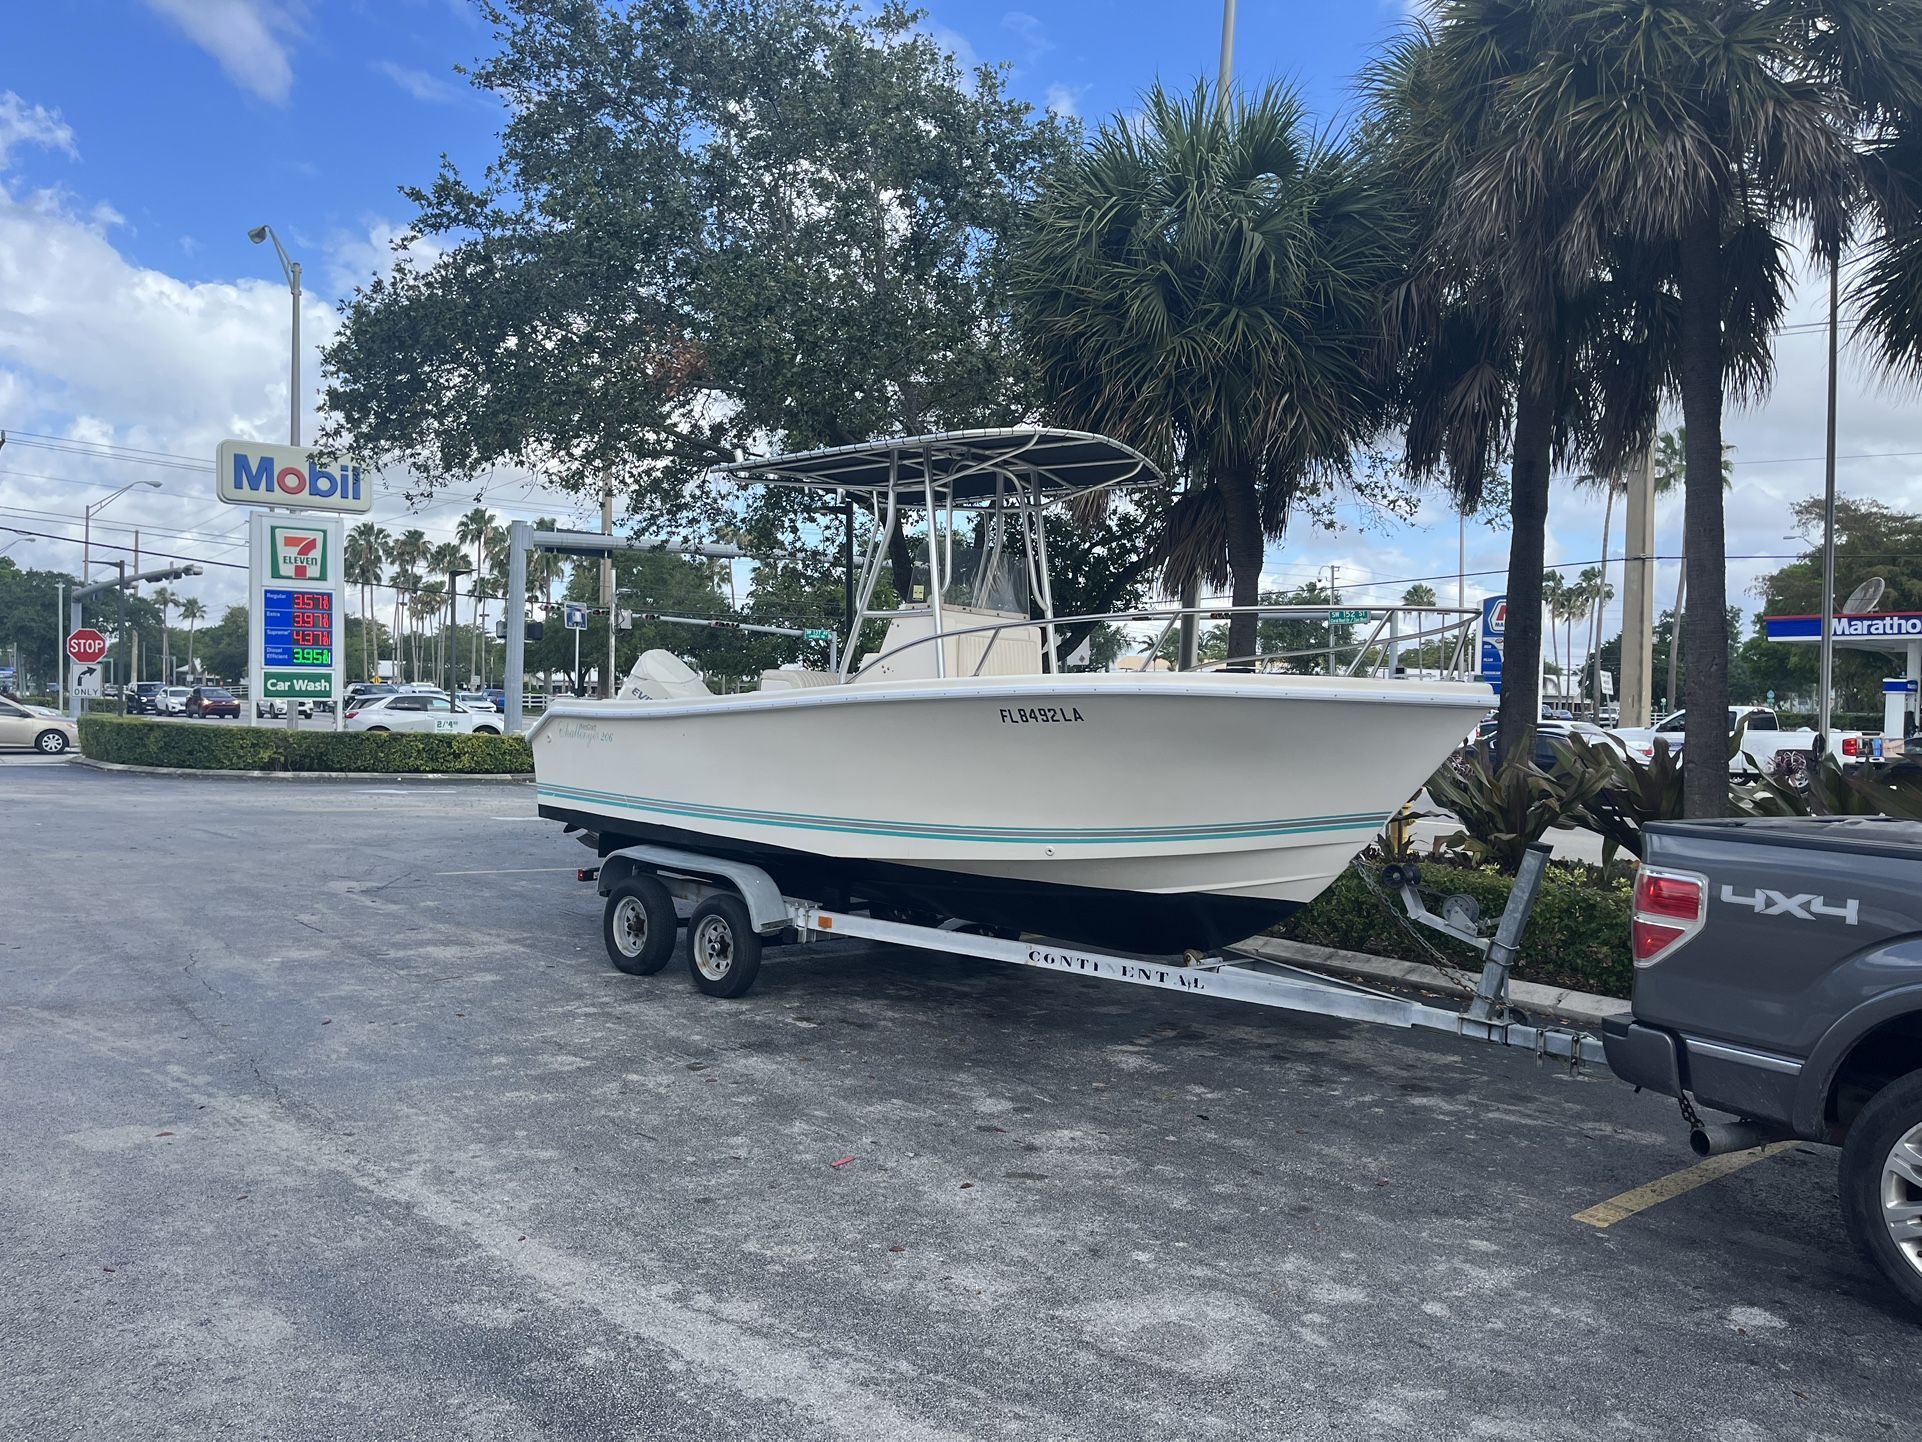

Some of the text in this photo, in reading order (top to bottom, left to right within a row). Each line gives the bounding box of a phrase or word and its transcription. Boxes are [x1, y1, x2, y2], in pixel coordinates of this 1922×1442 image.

[233, 453, 361, 500] Mobil
[283, 535, 317, 578] 7
[1343, 610, 1355, 618] 152
[1832, 617, 1922, 635] Maratho
[70, 639, 104, 653] STOP
[74, 688, 99, 696] ONLY
[266, 679, 330, 691] Car Wash
